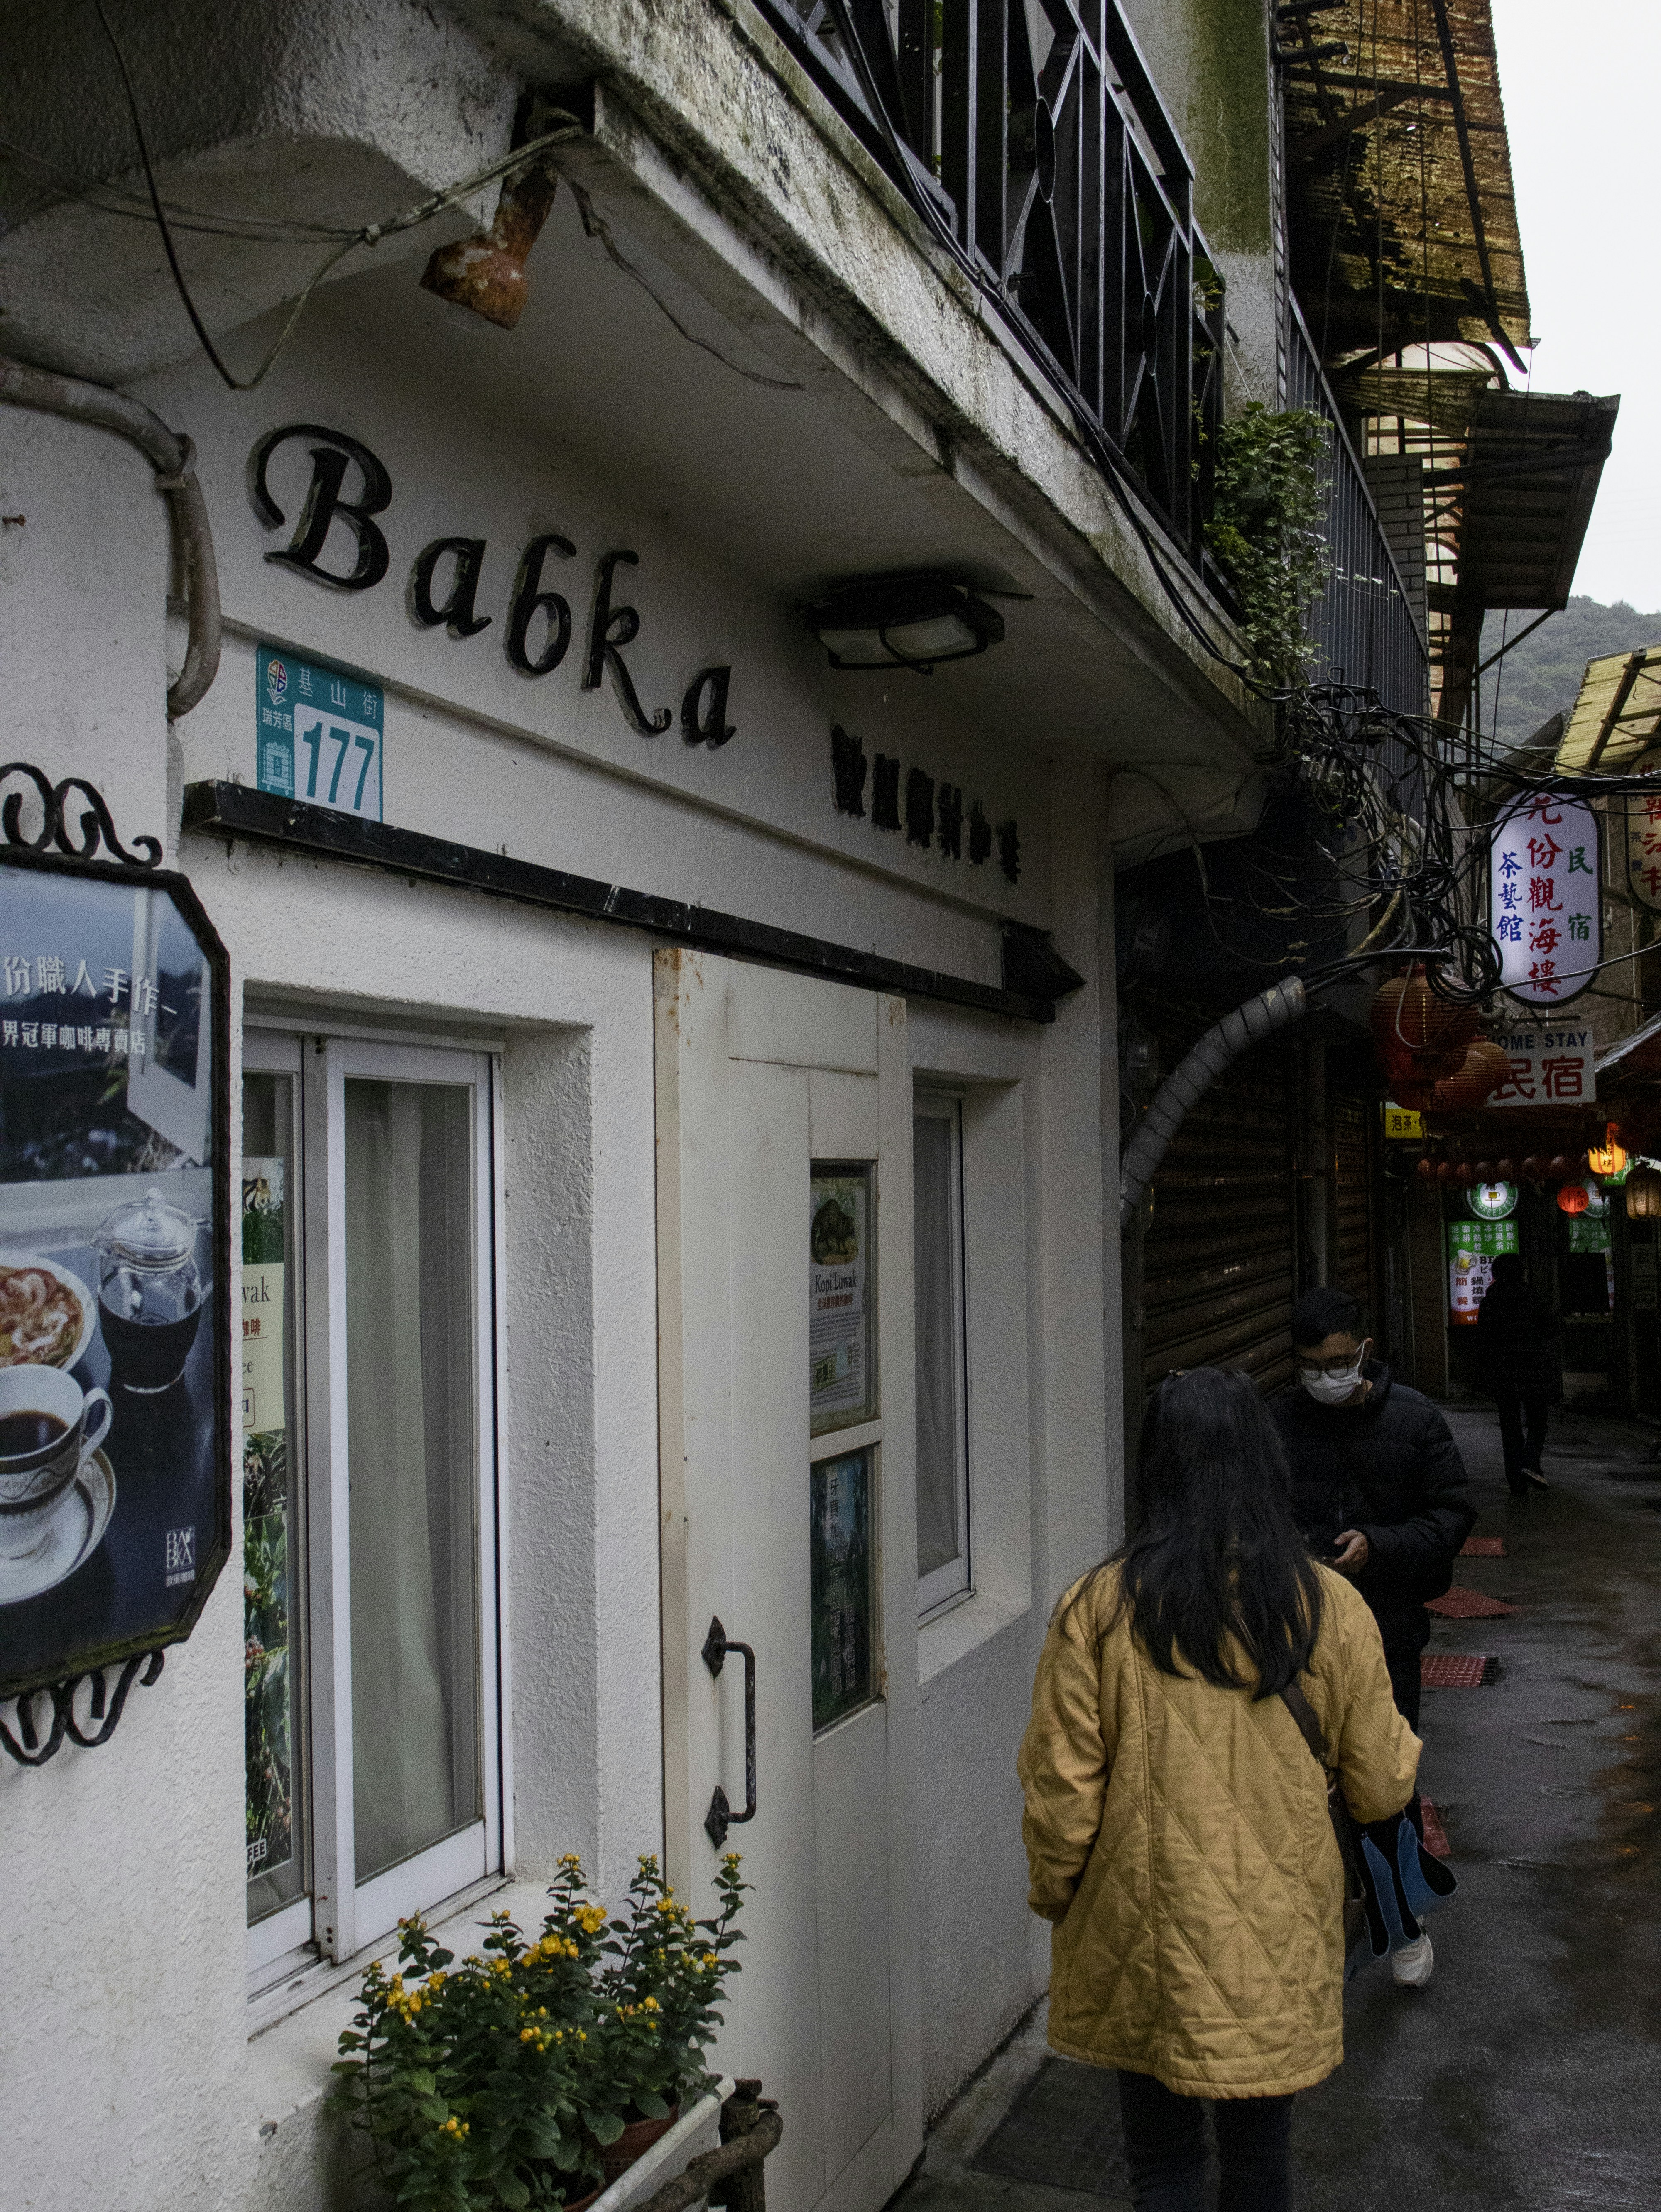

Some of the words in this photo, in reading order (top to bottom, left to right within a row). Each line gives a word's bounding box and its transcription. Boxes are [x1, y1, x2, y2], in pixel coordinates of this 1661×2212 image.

[299, 667, 377, 719] 基山街
[262, 707, 293, 732] 瑞芳區
[302, 721, 375, 810] 177
[1496, 851, 1524, 942] 茶藝館
[1567, 846, 1594, 941] 民宿
[1491, 1034, 1534, 1049] OME
[1545, 1032, 1587, 1048] STAY
[1493, 1055, 1584, 1099] 民宿
[815, 1274, 832, 1296] Kopi
[834, 1269, 857, 1290] Luwak
